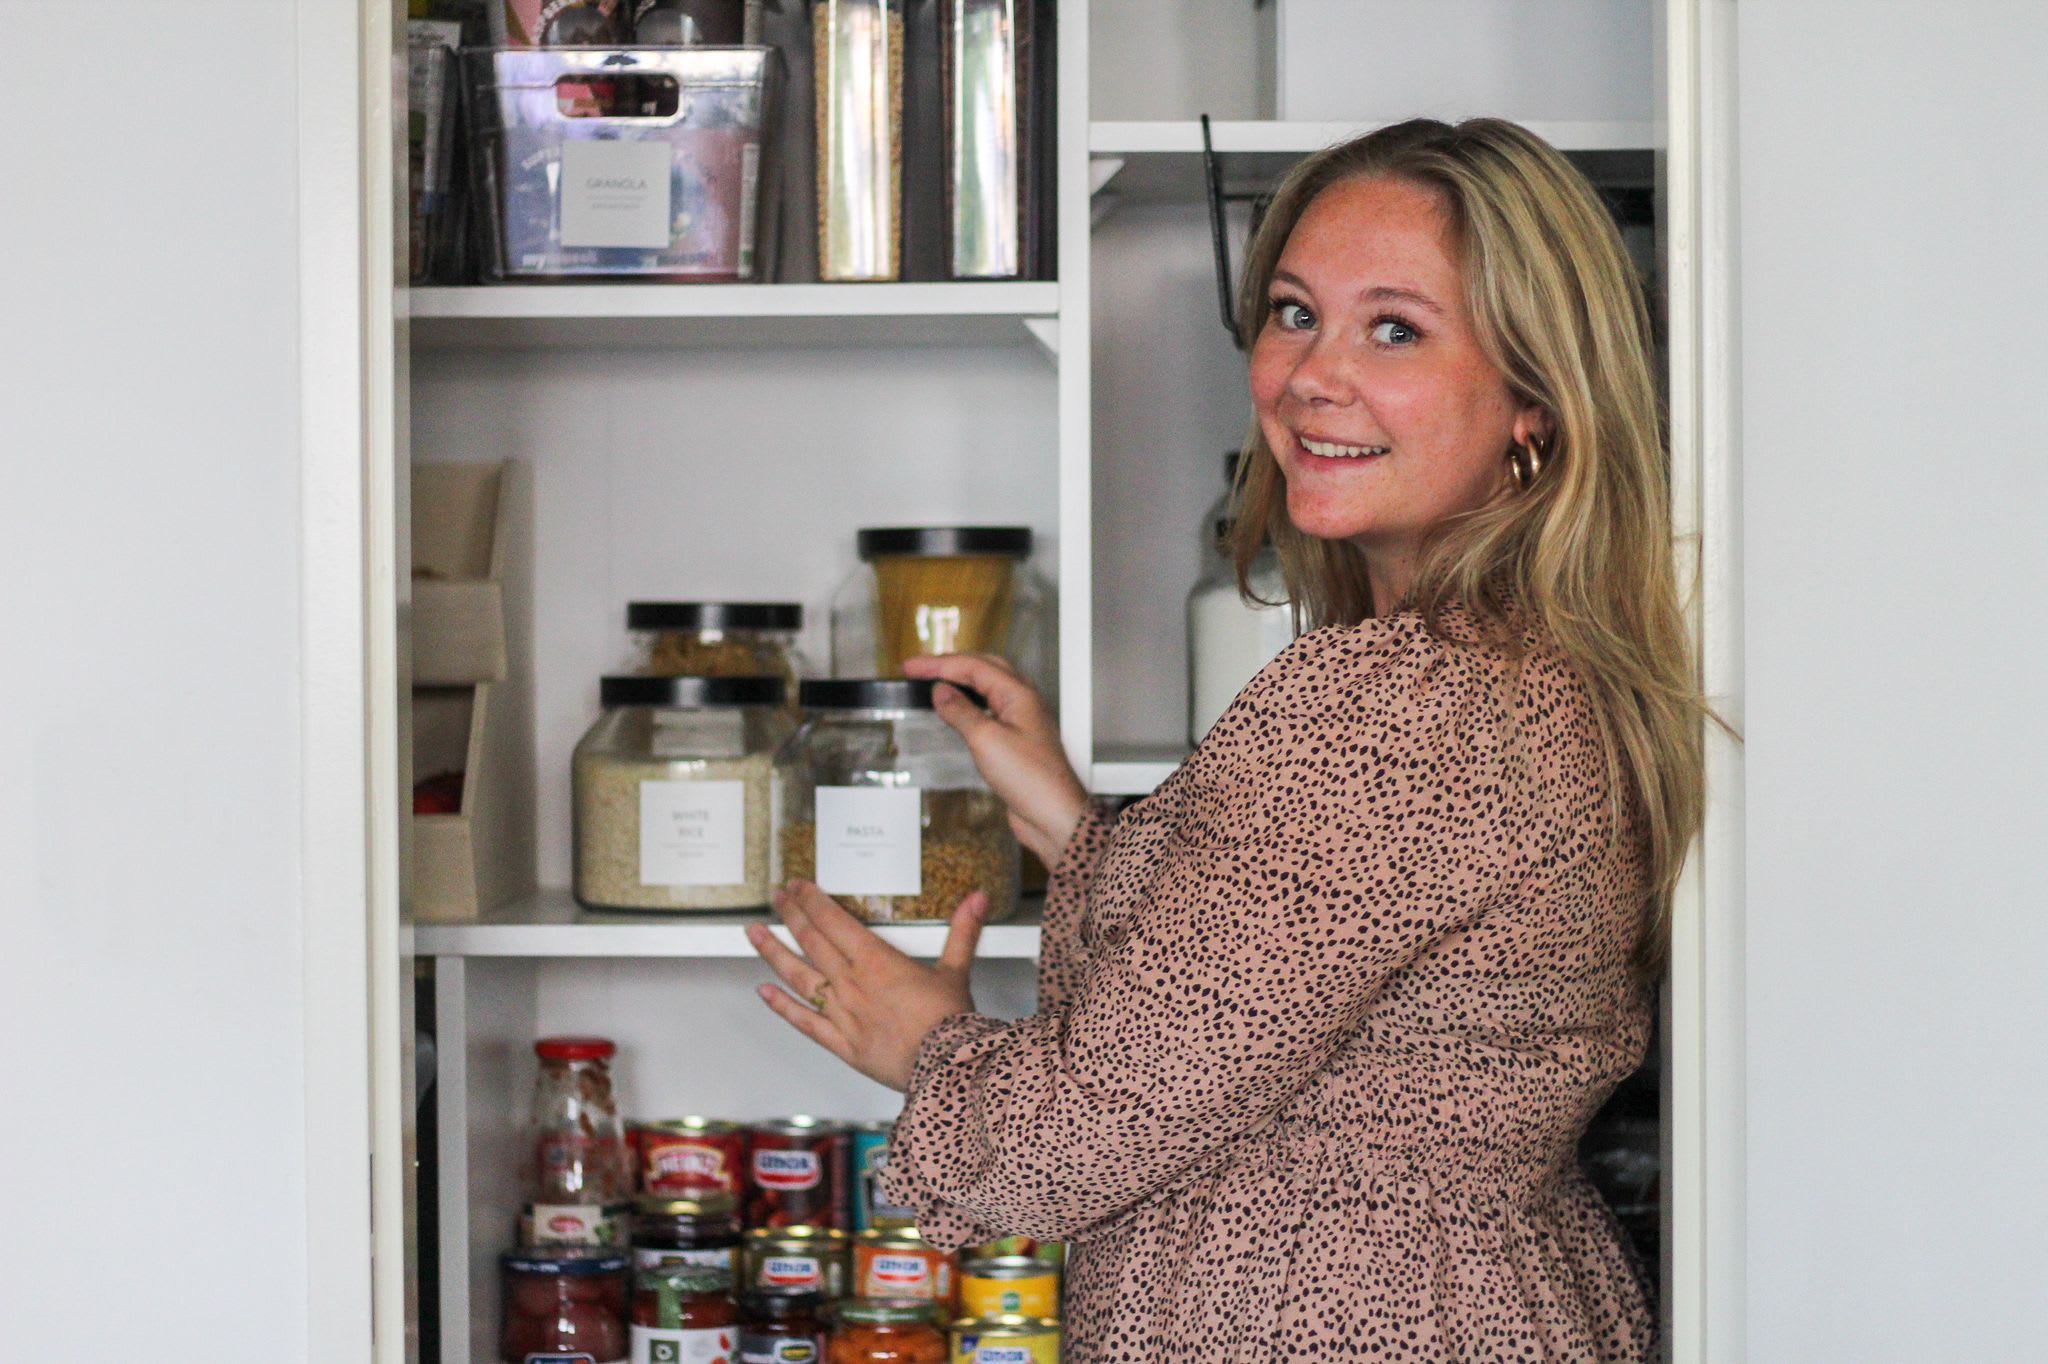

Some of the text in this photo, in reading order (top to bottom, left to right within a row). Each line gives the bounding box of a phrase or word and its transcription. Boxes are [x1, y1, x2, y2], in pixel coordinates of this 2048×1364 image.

[586, 178, 646, 190] GRANOLA
[672, 809, 710, 823] WHITE
[678, 827, 705, 839] RICE
[846, 826, 884, 838] PASTA
